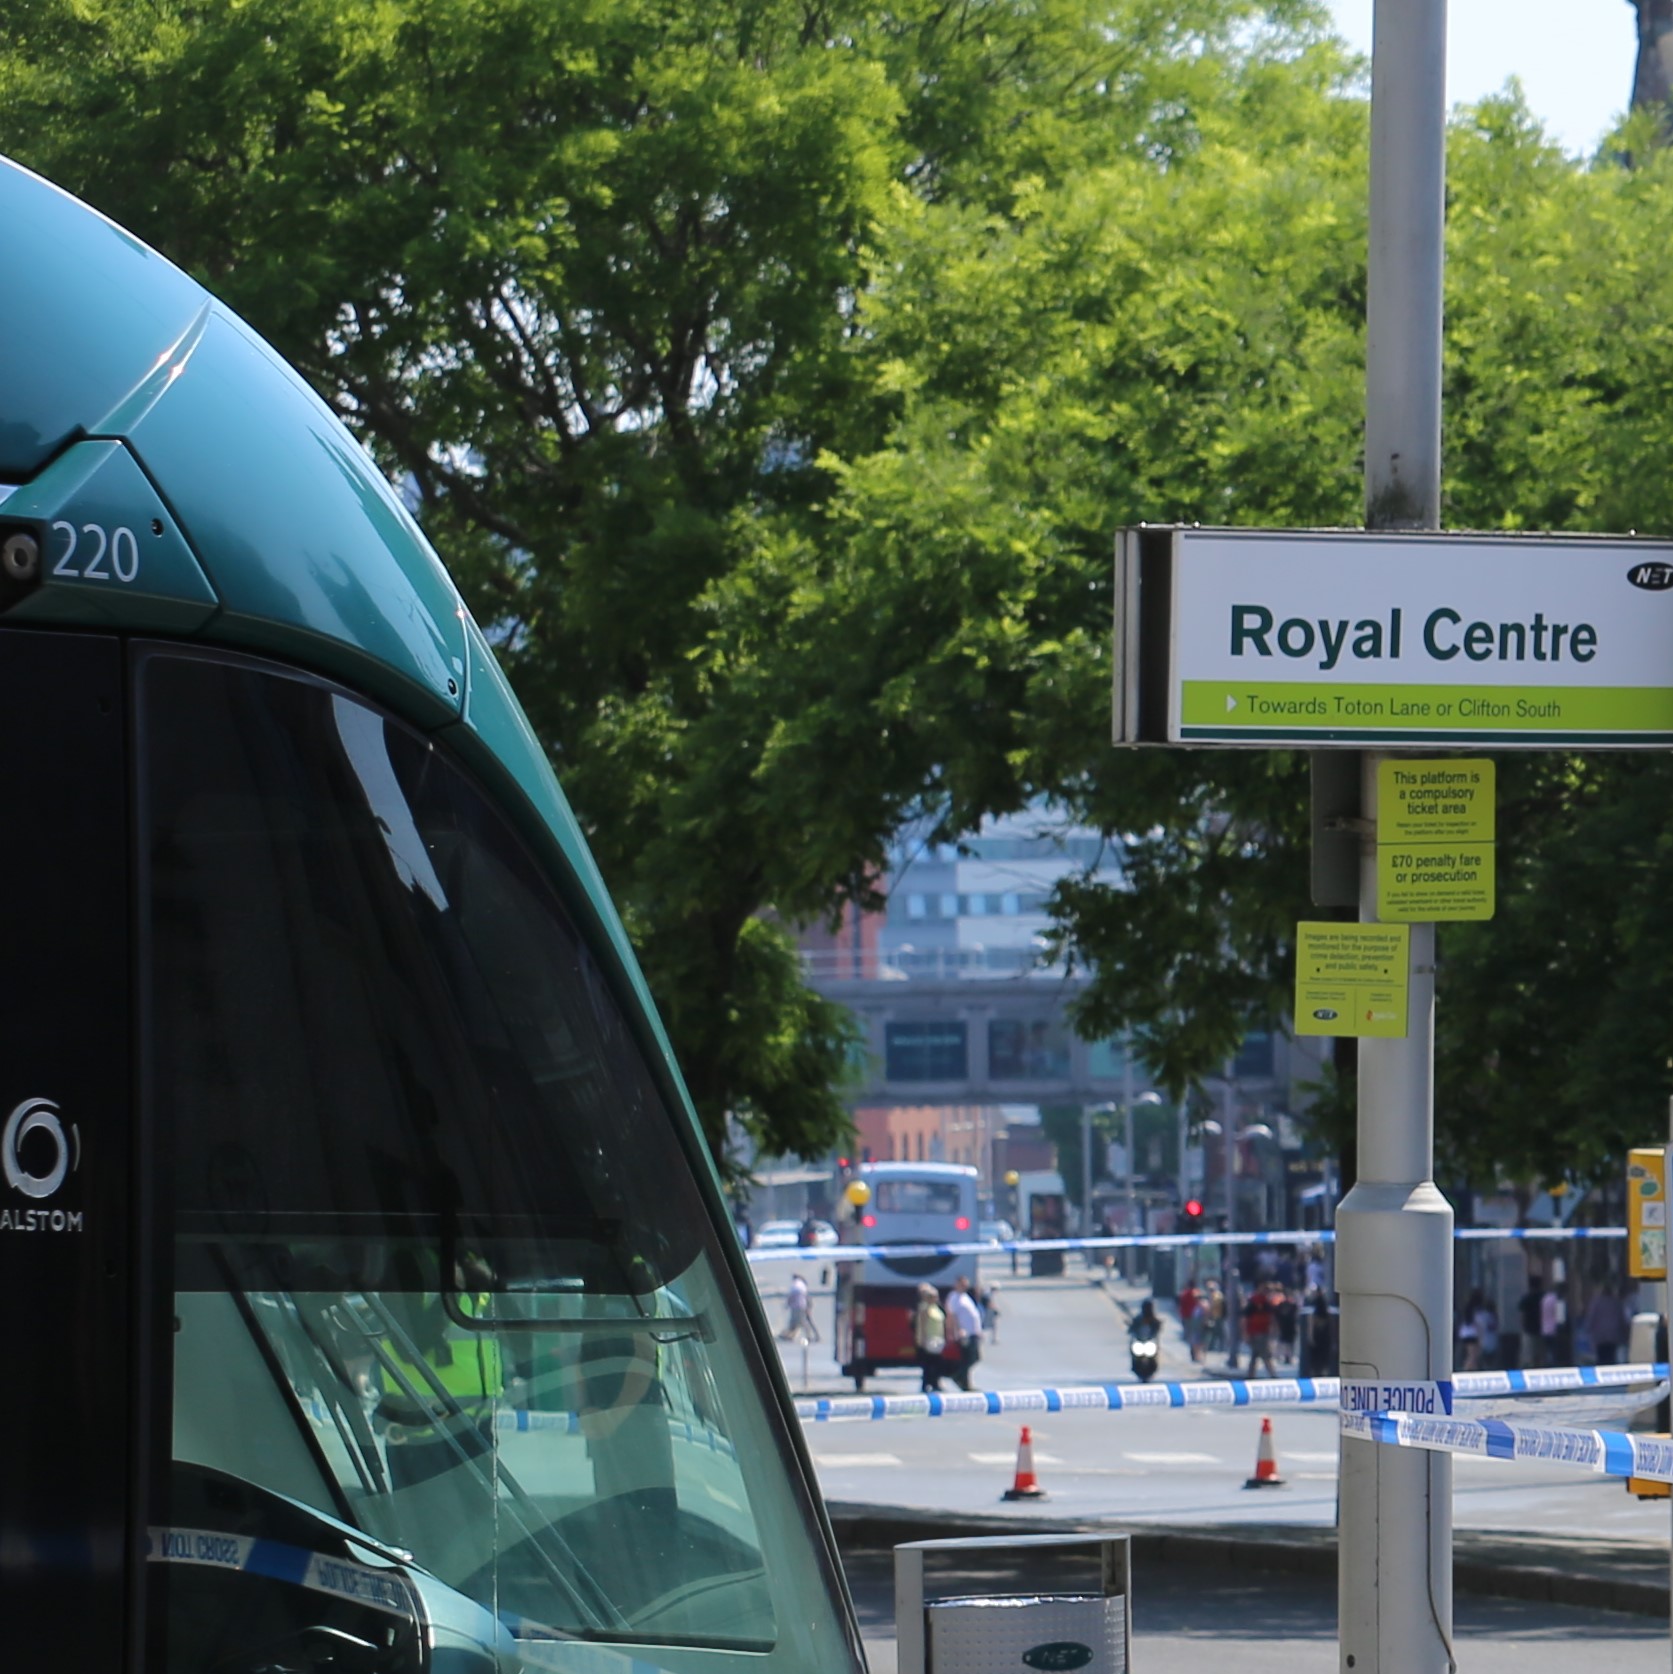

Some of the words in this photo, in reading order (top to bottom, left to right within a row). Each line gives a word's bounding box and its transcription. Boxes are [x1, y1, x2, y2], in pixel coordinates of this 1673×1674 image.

[52, 520, 139, 583] 220
[1230, 604, 1402, 670] Royal
[1423, 607, 1598, 663] Centre
[1247, 695, 1327, 716] Towards
[1334, 697, 1384, 716] Toton
[1389, 698, 1431, 717] Lane
[1437, 703, 1453, 717] or
[1458, 698, 1510, 718] Clifton
[1515, 699, 1562, 718] South
[1393, 771, 1417, 785] This
[1420, 770, 1467, 787] platform
[1470, 770, 1480, 783] is
[1399, 789, 1406, 800] a
[1409, 786, 1475, 802] compulsory
[1407, 802, 1438, 815] ticket
[1441, 803, 1466, 815] area
[1391, 854, 1413, 868] £70
[1416, 853, 1457, 869] penalty
[1459, 852, 1482, 866] fare
[1395, 872, 1407, 883] or
[1411, 869, 1477, 885] prosecution
[0, 1209, 83, 1232] ALSTOM
[1351, 1385, 1379, 1412] LINE
[1382, 1386, 1435, 1414] POLICE
